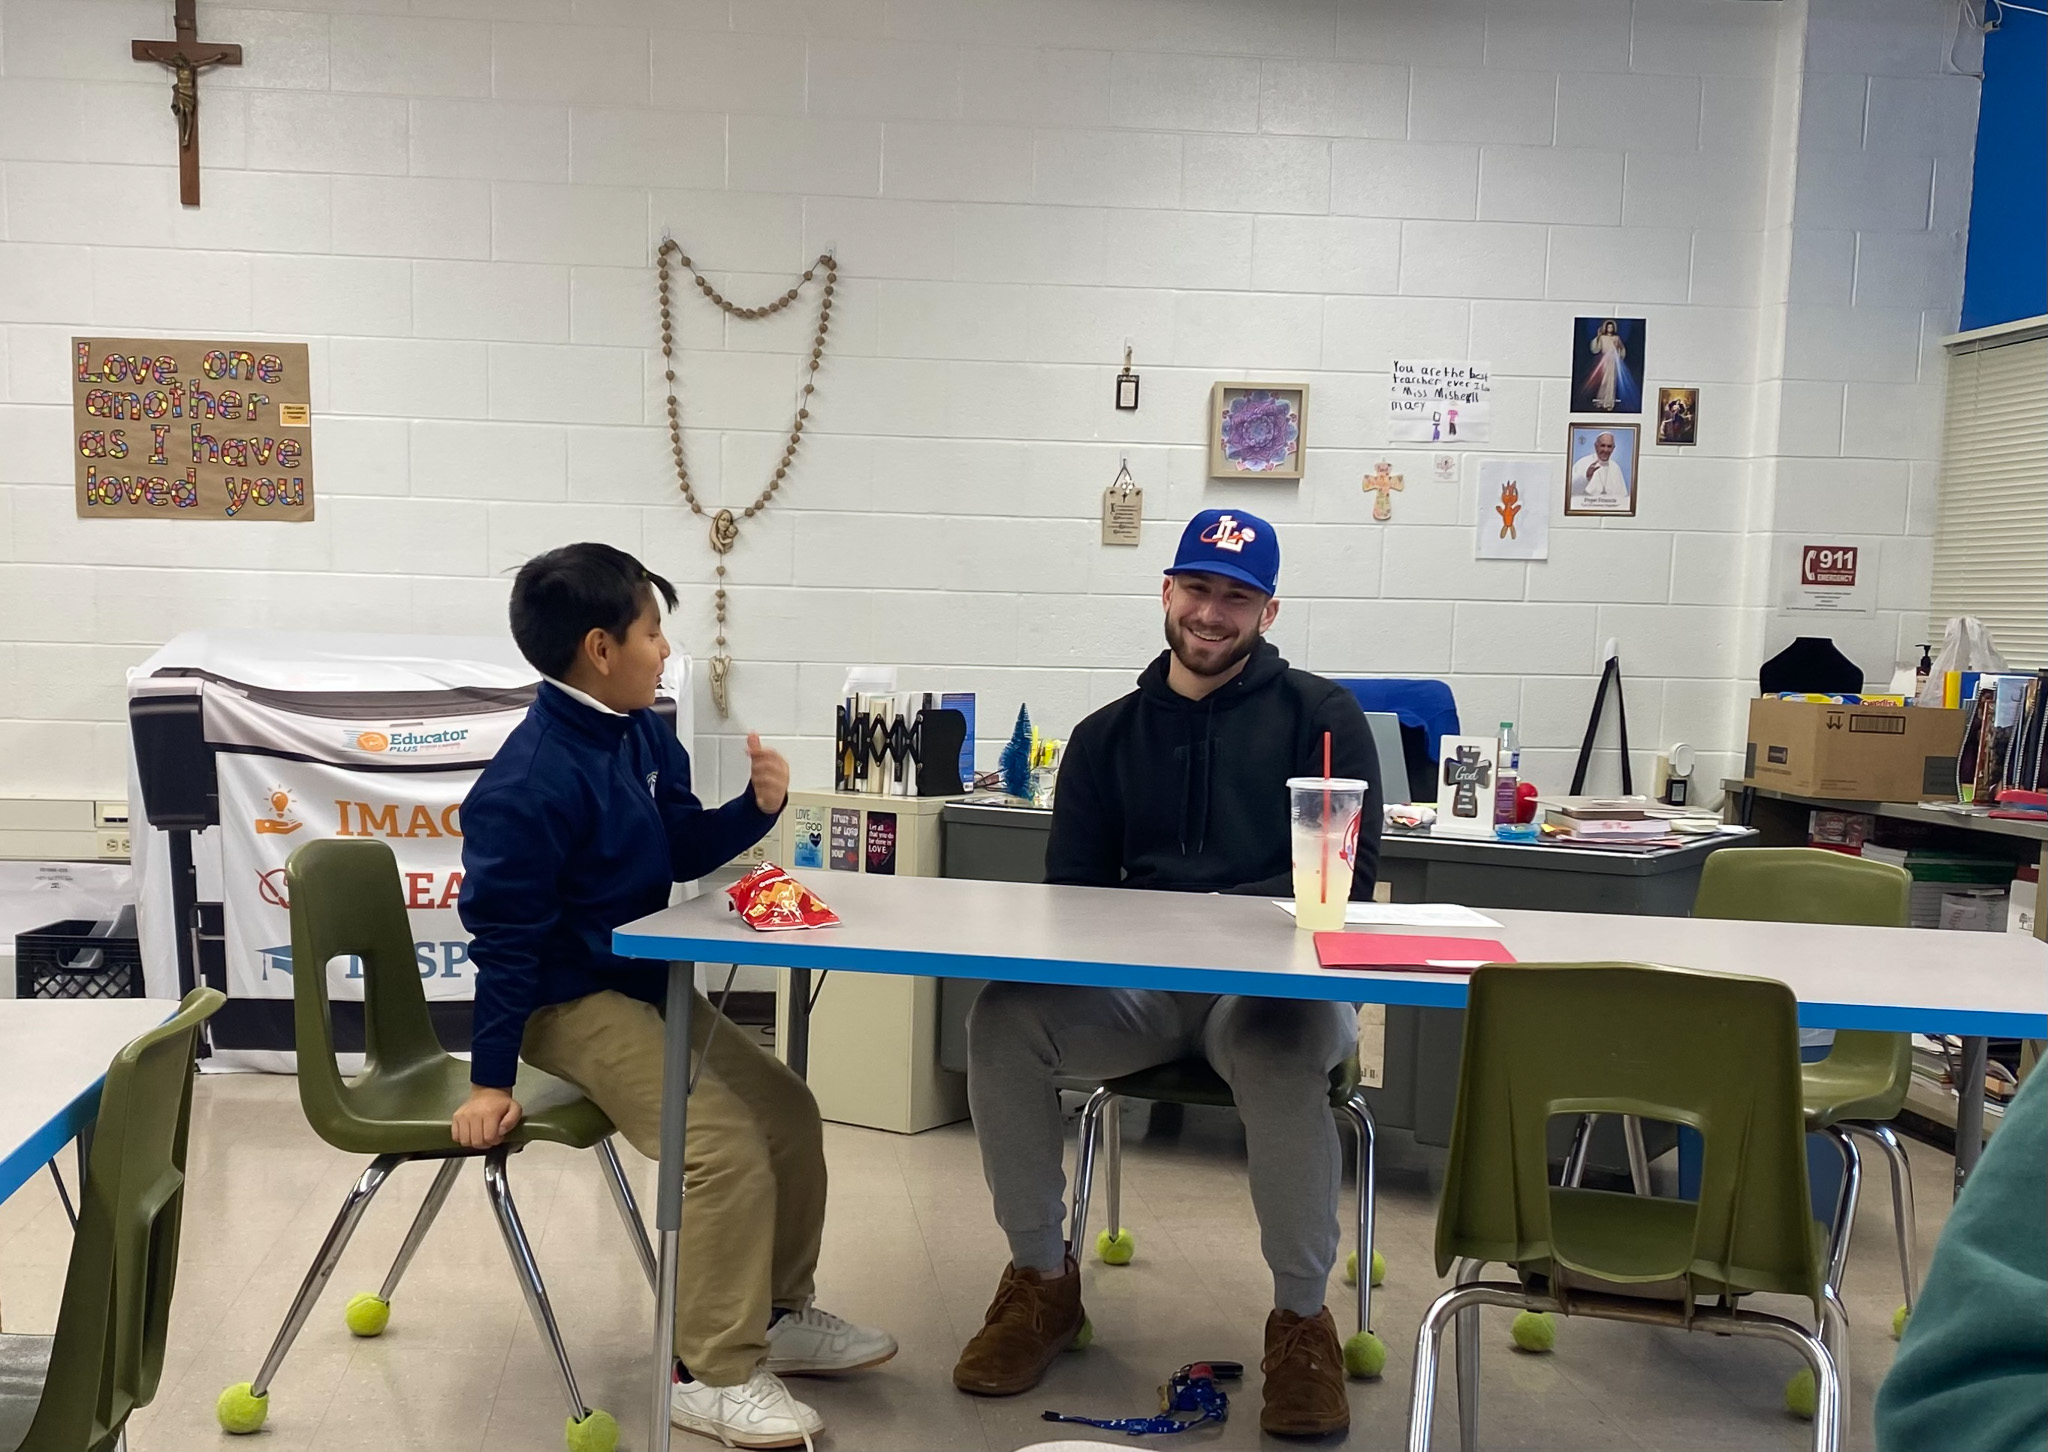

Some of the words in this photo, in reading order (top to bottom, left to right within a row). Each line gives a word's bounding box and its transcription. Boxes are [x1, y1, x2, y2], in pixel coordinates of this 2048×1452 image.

[77, 341, 178, 386] Love
[202, 350, 283, 384] one
[1393, 360, 1414, 374] You
[1421, 366, 1441, 377] are
[1444, 367, 1465, 378] the
[1402, 386, 1428, 398] Miss
[1447, 380, 1470, 388] ever
[86, 379, 270, 421] another
[79, 429, 129, 459] as
[148, 424, 170, 465] I
[191, 422, 302, 469] have
[87, 465, 199, 508] loved
[224, 477, 304, 517] you
[1819, 550, 1854, 569] 911
[389, 729, 469, 745] Educator
[389, 745, 418, 753] PLUS
[1455, 765, 1479, 781] God
[795, 809, 811, 820] LOVE
[806, 822, 822, 831] GOD
